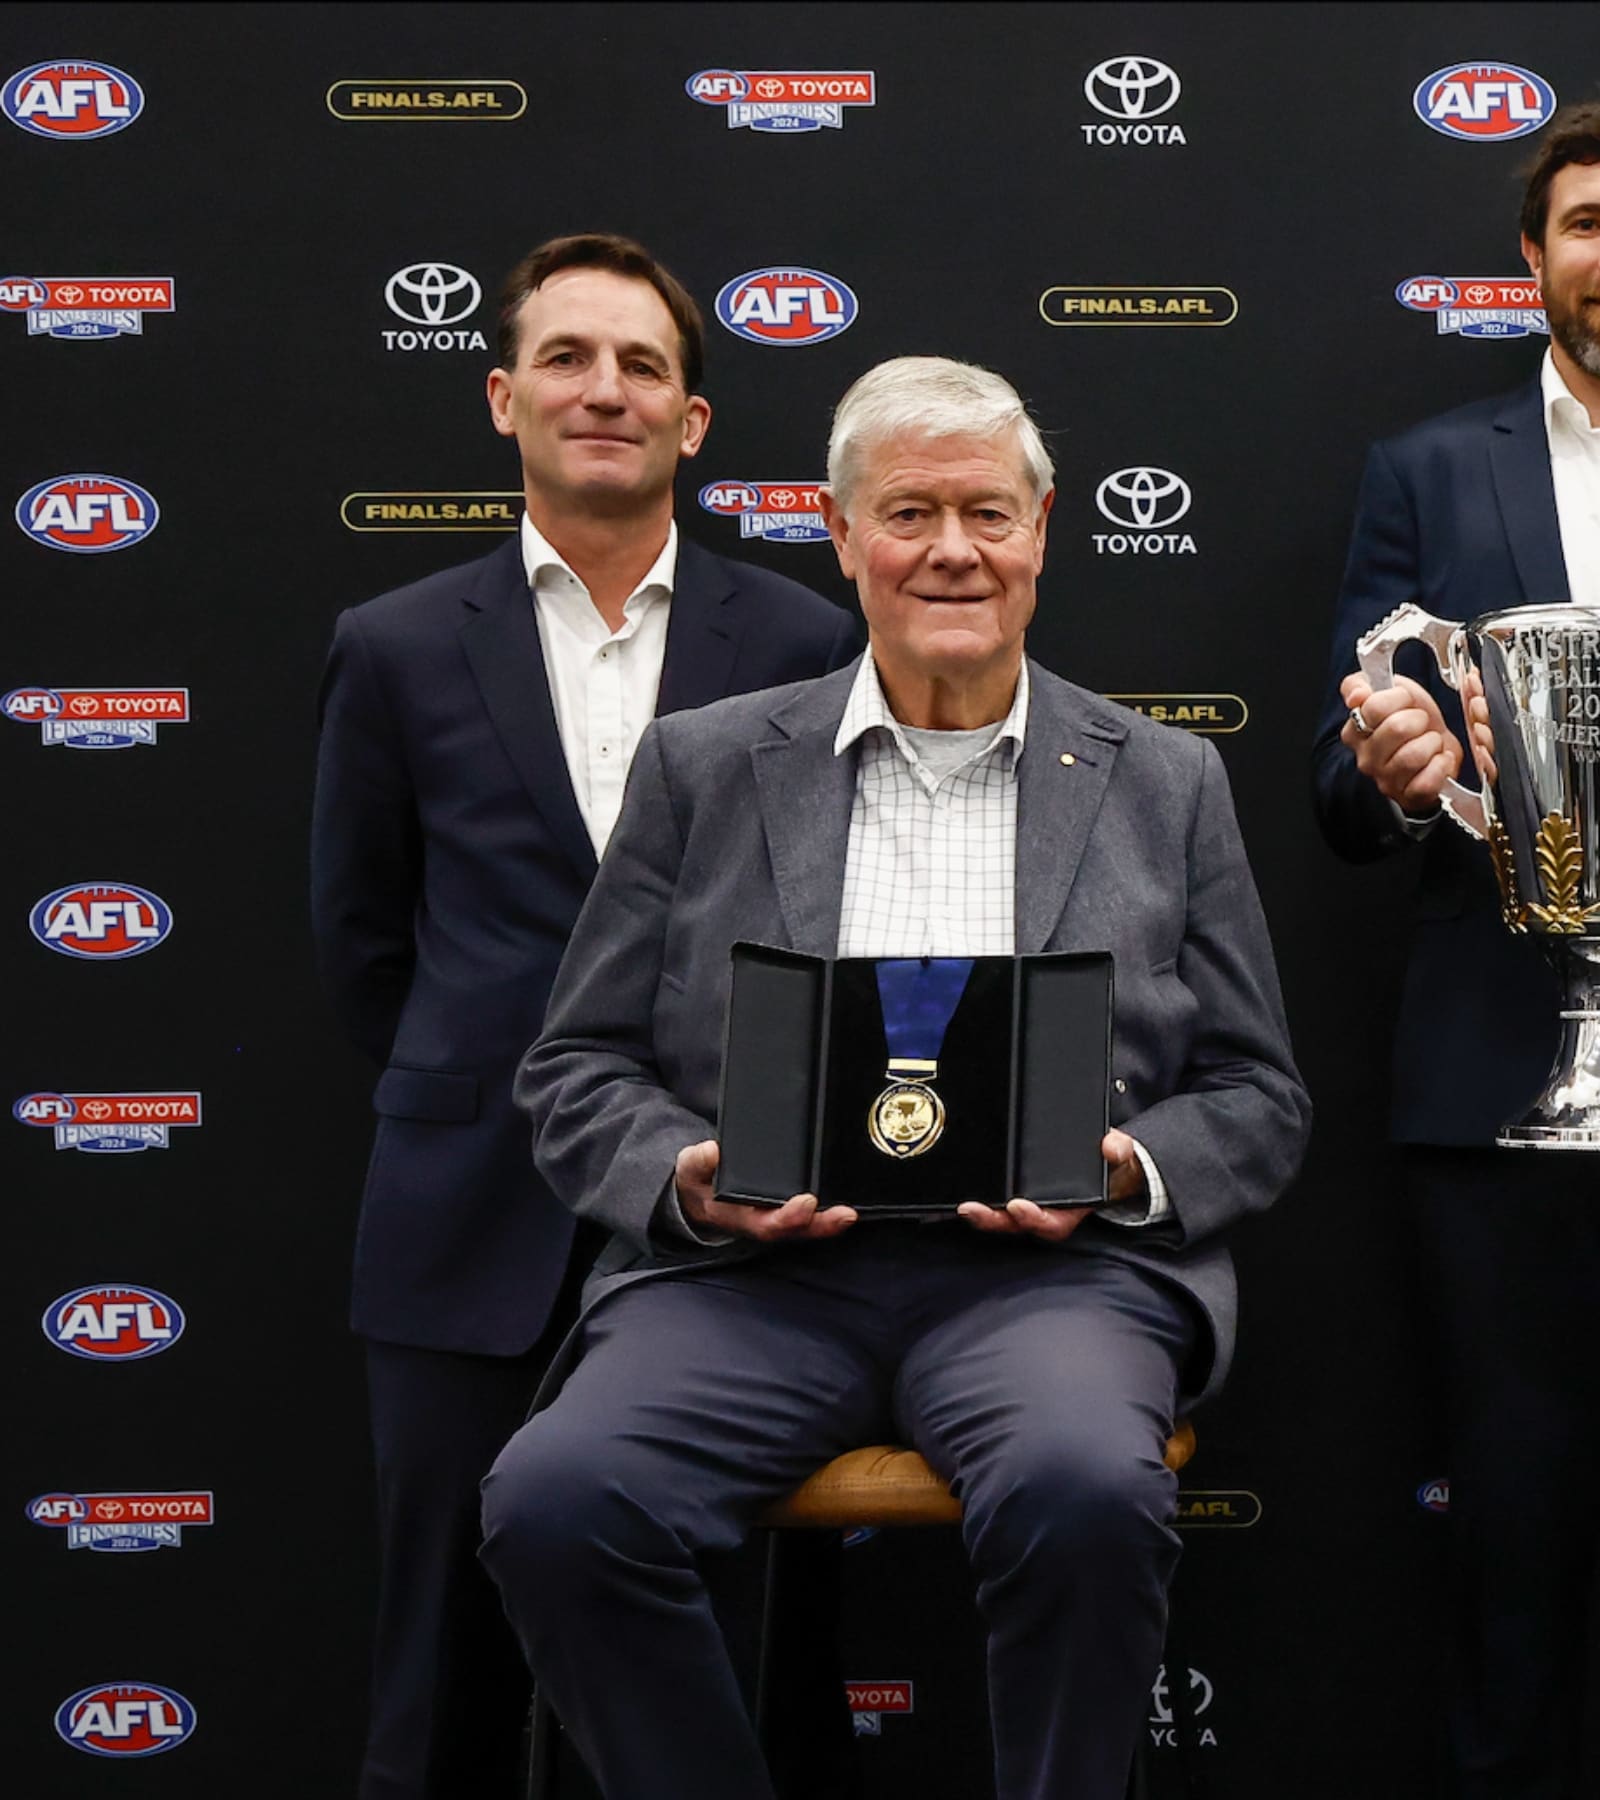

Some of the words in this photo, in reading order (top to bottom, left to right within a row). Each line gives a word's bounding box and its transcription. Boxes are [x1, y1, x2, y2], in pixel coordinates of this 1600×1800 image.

[693, 78, 746, 97] AFL
[789, 81, 867, 96] TOYOTA
[16, 80, 131, 118] AFL
[351, 92, 502, 108] FINALS.AFL
[1428, 83, 1541, 120] AFL
[1081, 124, 1187, 146] TOYOTA
[89, 288, 167, 303] TOYOTA
[1403, 284, 1455, 302] AFL
[729, 287, 845, 325] AFL
[1064, 299, 1213, 314] FINALS.AFL
[1481, 324, 1508, 334] 2024
[381, 331, 488, 351] TOYOTA
[705, 488, 757, 507] AFL
[31, 494, 146, 531] AFL
[365, 504, 515, 519] FINALS.AFL
[1092, 534, 1198, 555] TOYOTA
[8, 696, 60, 714] AFL
[104, 698, 181, 713] TOYOTA
[44, 902, 159, 939] AFL
[20, 1101, 72, 1119] AFL
[117, 1102, 194, 1118] TOYOTA
[60, 1303, 173, 1340] AFL
[33, 1501, 85, 1519] AFL
[129, 1502, 206, 1517] TOYOTA
[70, 1702, 184, 1738] AFL
